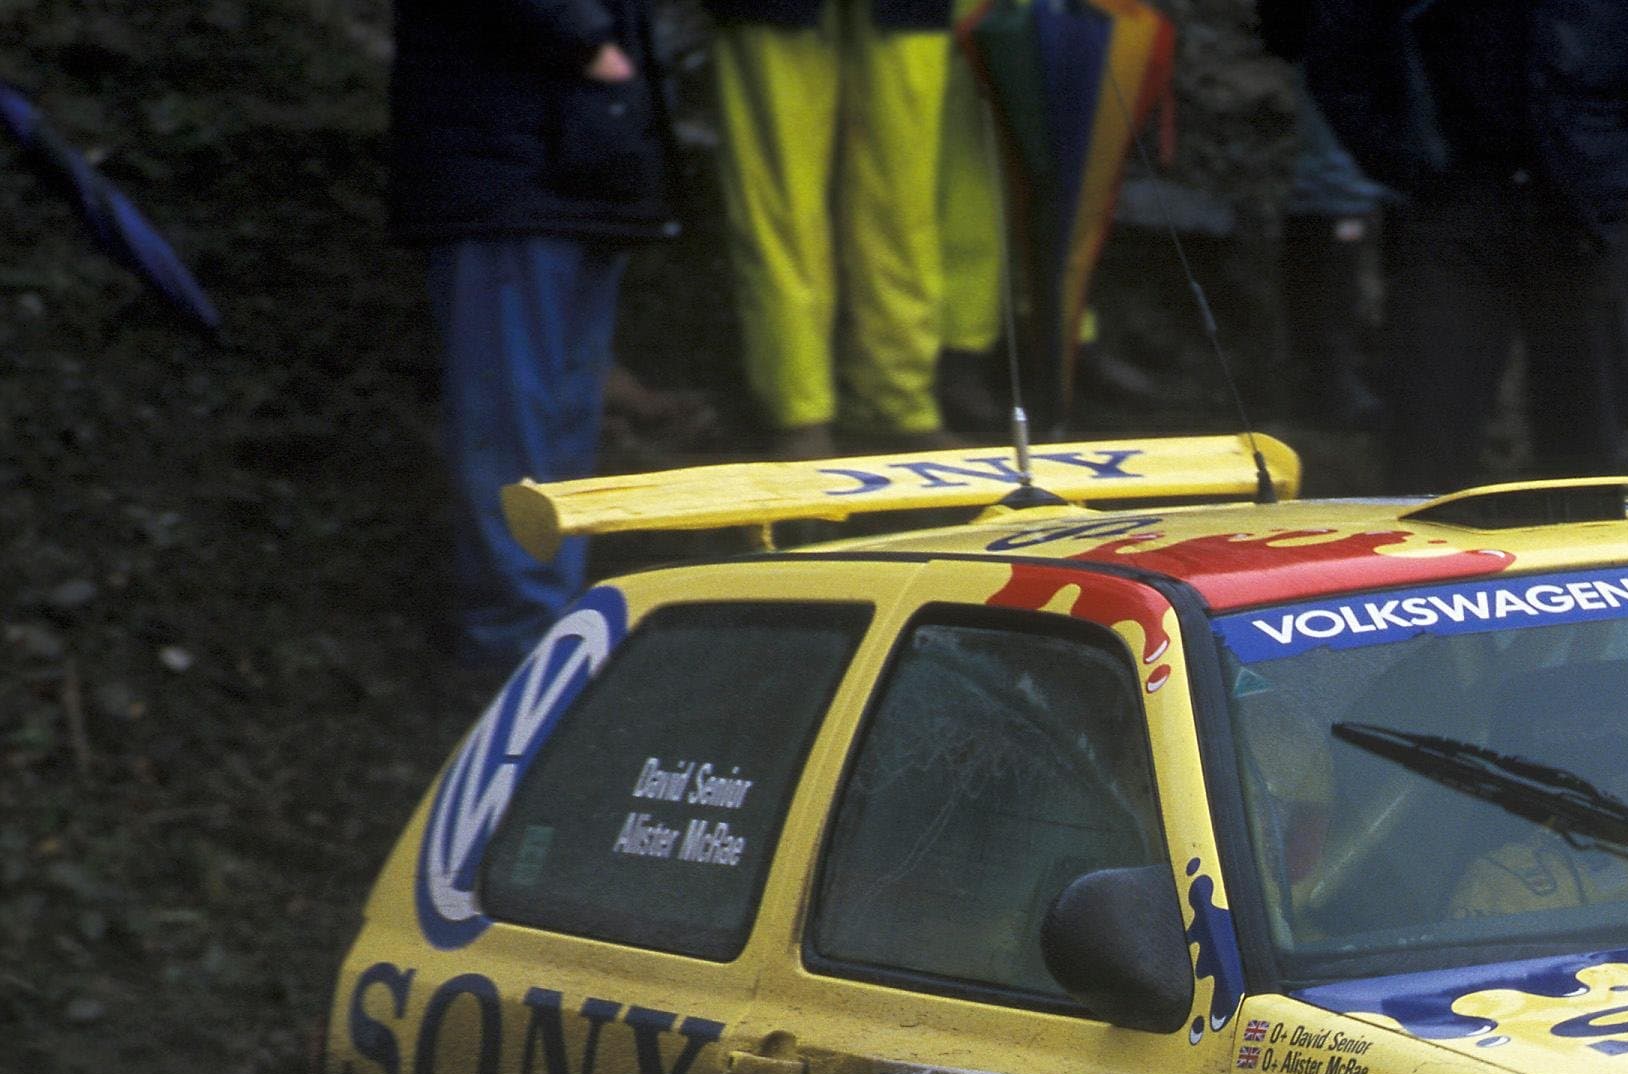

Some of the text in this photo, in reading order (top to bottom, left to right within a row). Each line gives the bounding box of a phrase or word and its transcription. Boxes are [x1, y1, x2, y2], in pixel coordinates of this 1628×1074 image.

[632, 757, 754, 809] David Senior
[613, 812, 746, 866] Alister McRae
[1289, 1025, 1331, 1050] David
[1328, 1031, 1375, 1056] Senior
